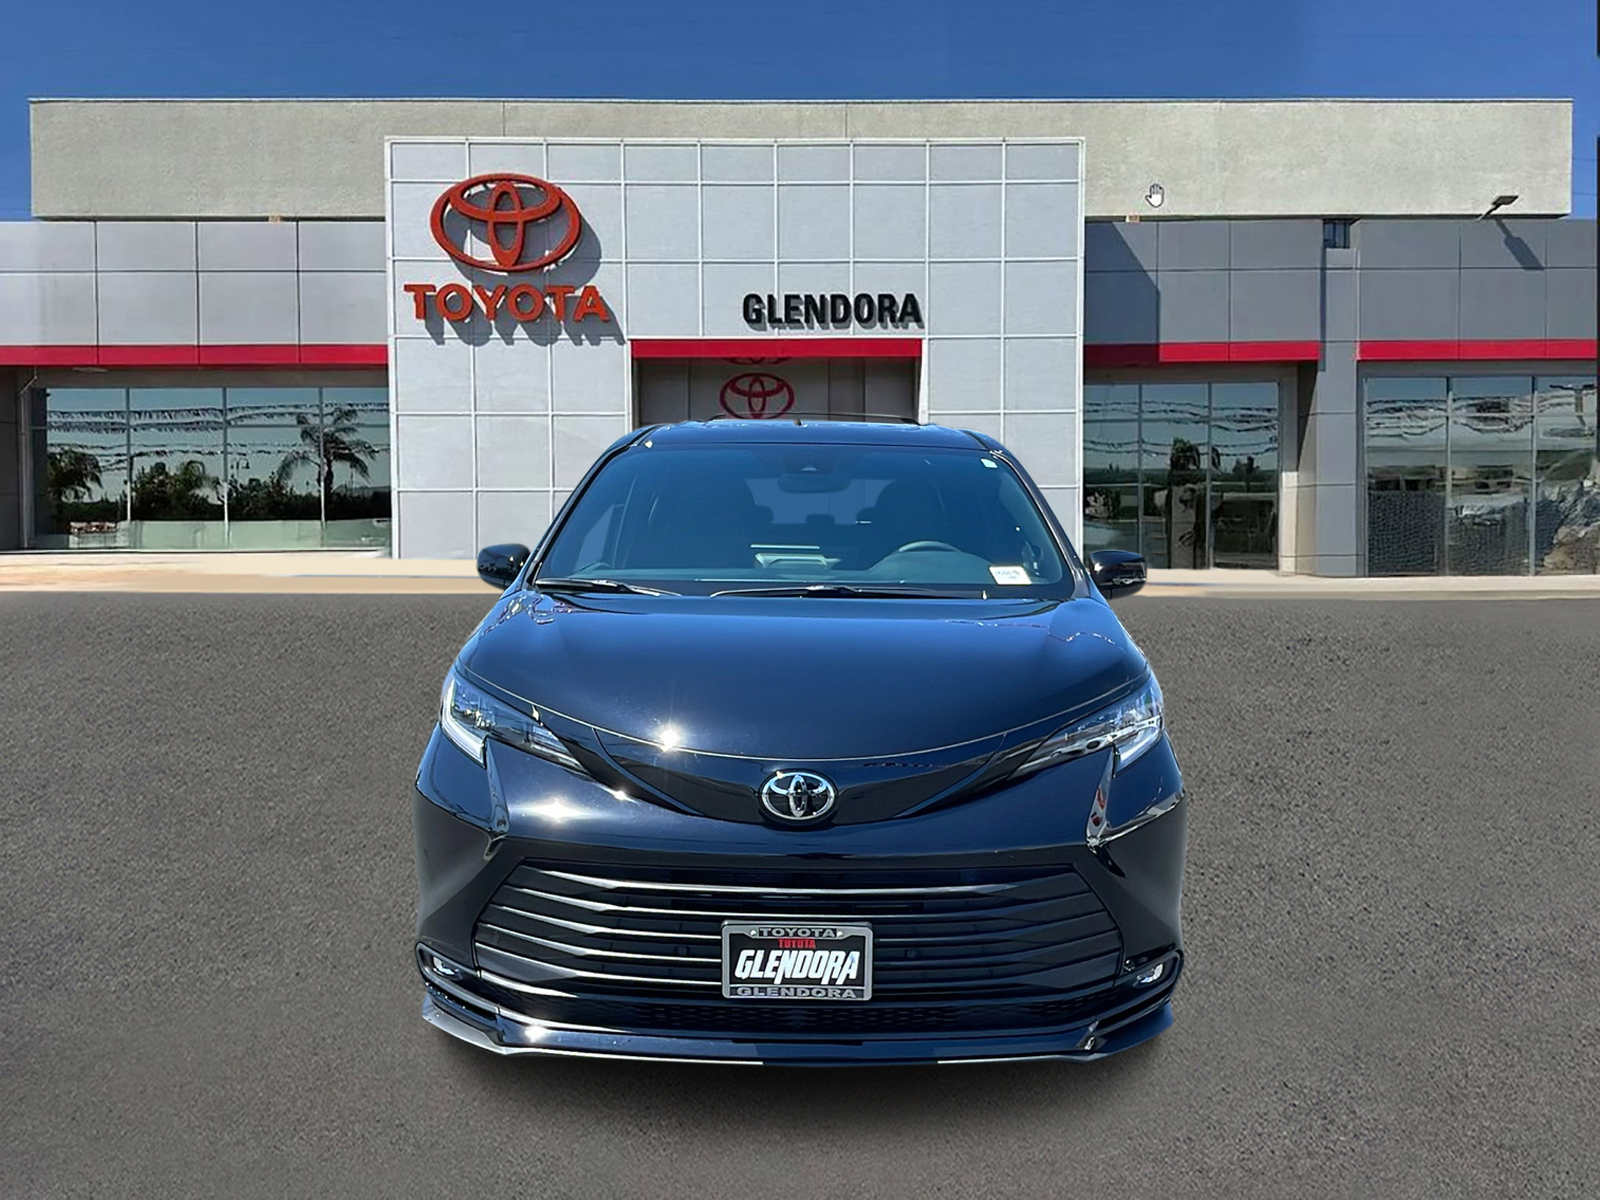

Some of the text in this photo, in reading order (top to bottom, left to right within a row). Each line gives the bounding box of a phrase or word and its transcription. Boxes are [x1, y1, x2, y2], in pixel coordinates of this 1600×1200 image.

[404, 284, 610, 322] TOYOTA
[743, 293, 922, 325] GLENDORA
[759, 928, 836, 938] TOYOTA
[778, 938, 816, 949] TOYOTA
[734, 949, 860, 985] GLENDORA
[736, 987, 857, 998] GLENDORA
